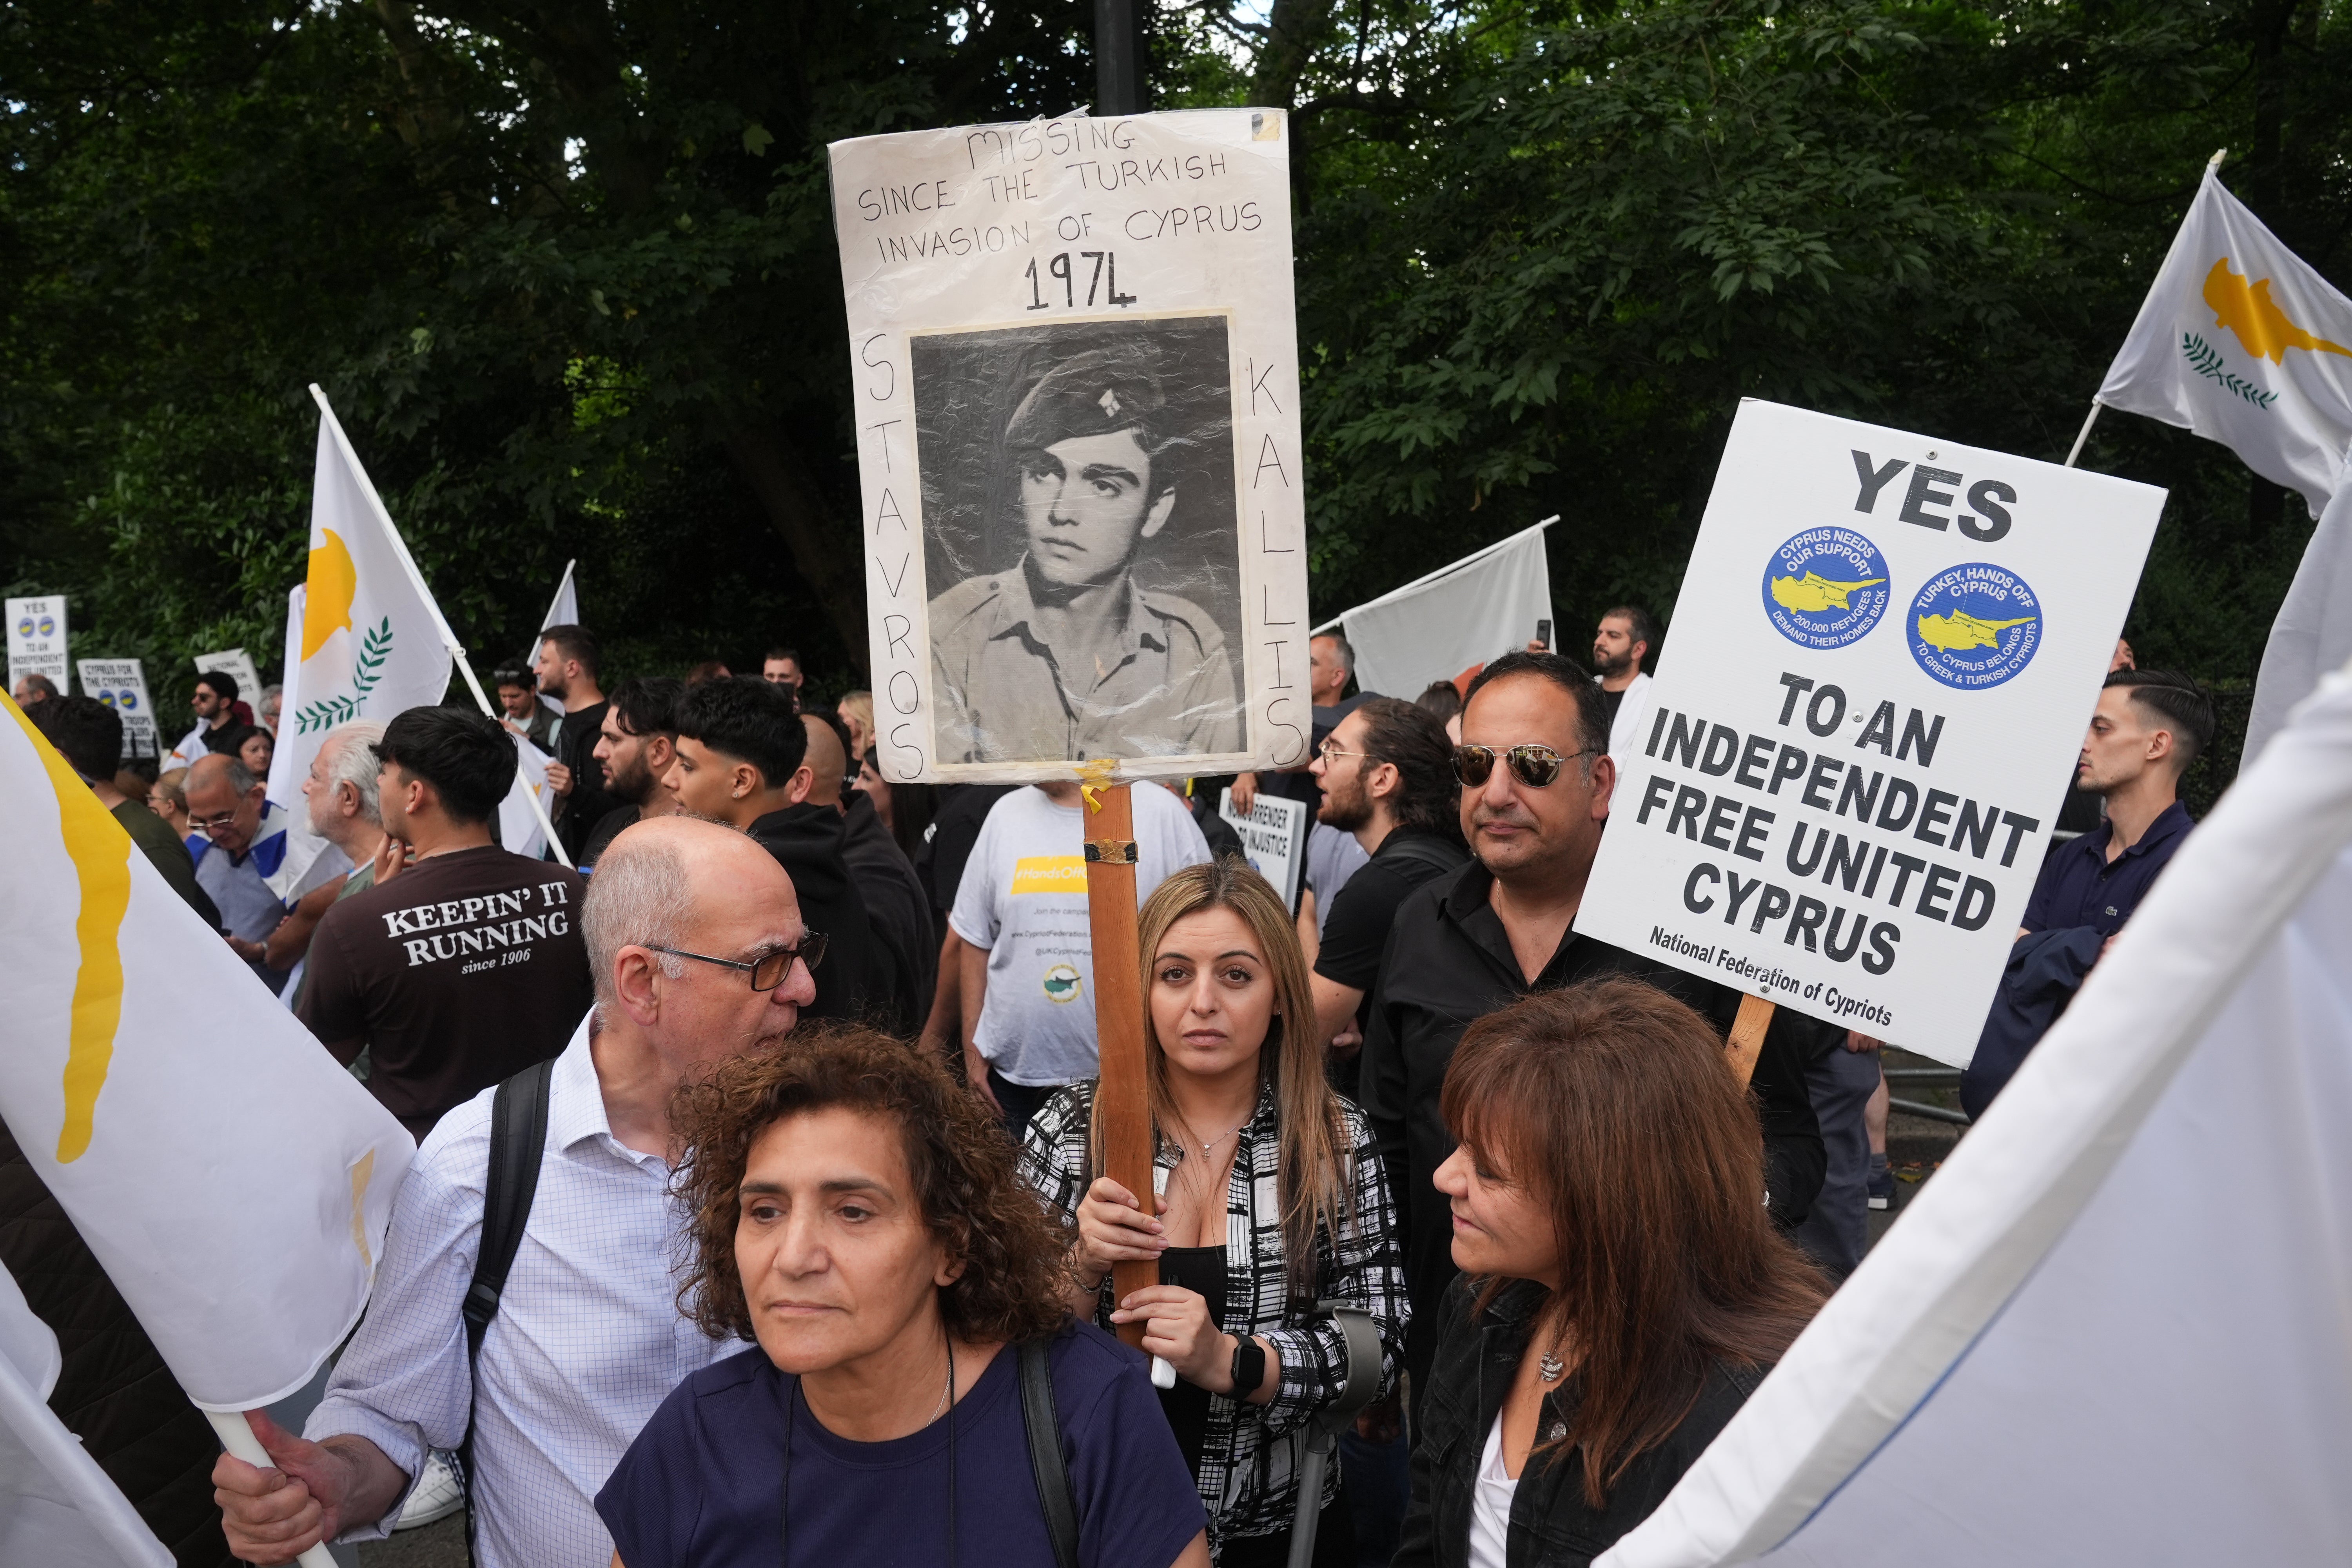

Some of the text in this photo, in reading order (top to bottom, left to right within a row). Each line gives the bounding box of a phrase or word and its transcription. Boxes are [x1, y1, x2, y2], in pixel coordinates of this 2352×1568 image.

[967, 120, 1134, 169] MISSING
[858, 153, 1225, 221] SINCE THE TURKISH
[877, 202, 1261, 263] INVASION OF CYPRUS
[1025, 252, 1136, 310] 1974
[1851, 449, 2017, 542] YES
[862, 334, 924, 779] STAVROS
[1250, 357, 1304, 765] KALLIS
[1780, 530, 1875, 559] CYPRUS NEEDS
[1786, 543, 1873, 576] OUR SUPPORT
[24, 603, 47, 613] YES
[1793, 591, 1871, 633] 200,000 REFUGEES
[1916, 568, 2034, 608] TURKEY, HANDS OFF
[1950, 581, 2007, 601] CYPRUS
[1772, 590, 1886, 646] DEMAND THEIR HOMES BACK
[1916, 623, 2036, 684] TO GREEK & TURKISH CYPRIOTS
[1942, 628, 2021, 671] CYPRUS BELONGS
[1778, 672, 1945, 768] TO AN
[1645, 708, 2040, 867] INDEPENDENT
[1238, 826, 1287, 857] TO INJUSTICE
[1241, 804, 1288, 829] RRENDER
[1637, 775, 1995, 931] FREE UNITED
[539, 882, 568, 907] IT
[1683, 863, 1901, 975] CYPRUS
[403, 911, 568, 967] RUNNING
[462, 948, 531, 975] since 1906
[1650, 926, 1892, 1026] National Federation of Cypriots
